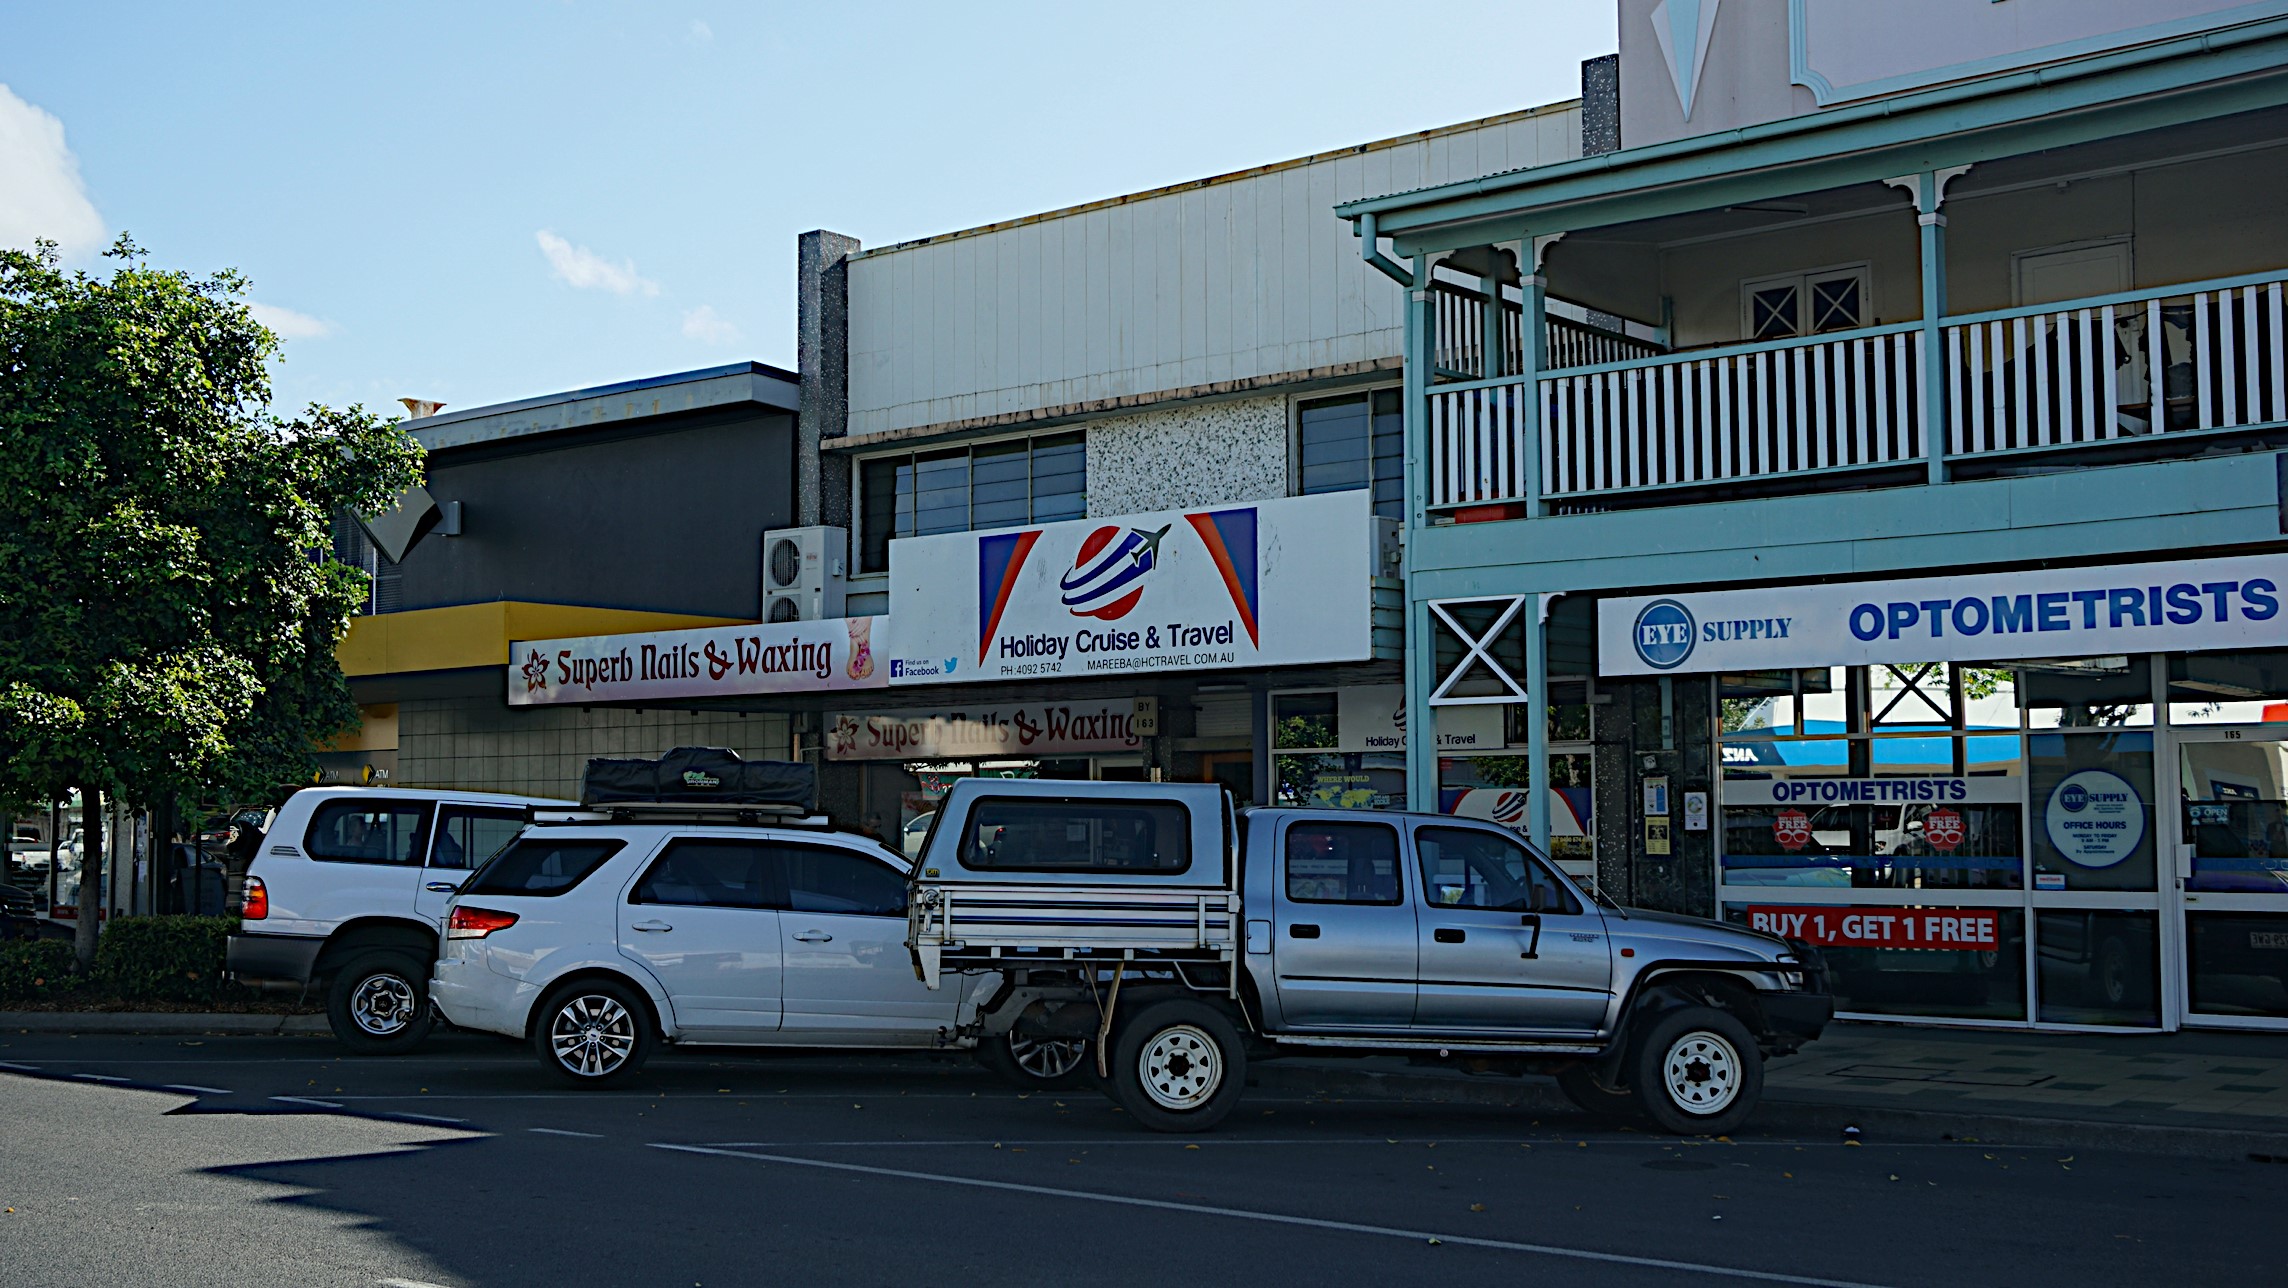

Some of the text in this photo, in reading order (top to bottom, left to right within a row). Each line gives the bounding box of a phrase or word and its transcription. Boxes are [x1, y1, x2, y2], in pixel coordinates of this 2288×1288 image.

[1849, 578, 2279, 642] OPTOMETRISTS
[1642, 617, 1792, 646] EYE SUPPLY
[1000, 620, 1234, 660] Holiday Cruise & Travel
[557, 636, 832, 691] Superb Nails & Waxing
[1040, 662, 1062, 674] 5742
[905, 666, 940, 676] Facebook
[1138, 702, 1150, 712] BY
[1013, 709, 1044, 746] &
[1044, 706, 1140, 746] Waxing
[1136, 718, 1154, 728] 163
[1445, 733, 1476, 745] Travel
[2224, 730, 2241, 739] 165
[1365, 736, 1400, 748] Holiday
[375, 769, 389, 779] ATM
[1317, 775, 1370, 783] WHERE WOULD
[1772, 779, 1967, 802] OPTOMETRISTS
[2063, 793, 2128, 803] EYE SUPPLY
[2203, 808, 2228, 816] OPEN
[1778, 821, 1807, 829] FREE
[1929, 820, 1960, 829] FREE
[2063, 821, 2127, 829] OFFICE HOURS
[1752, 912, 1994, 943] BUY 1, GET 1 FREE
